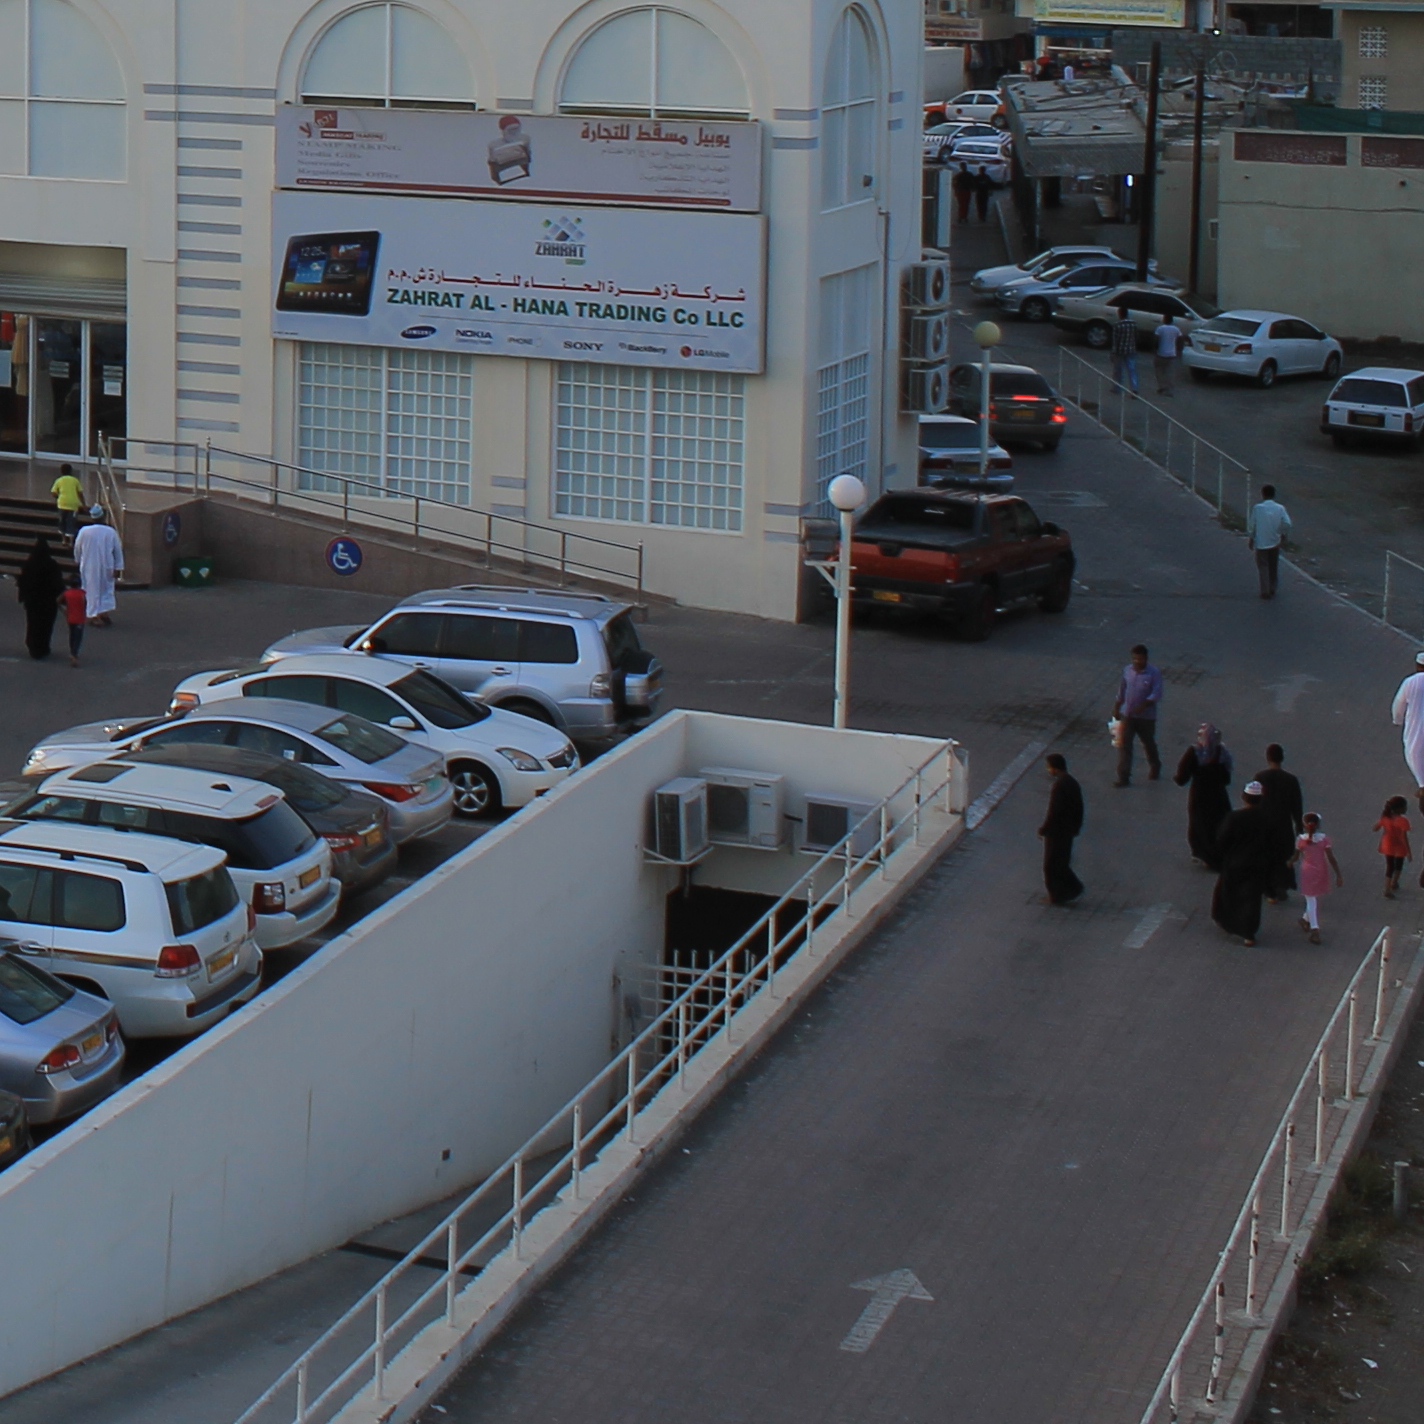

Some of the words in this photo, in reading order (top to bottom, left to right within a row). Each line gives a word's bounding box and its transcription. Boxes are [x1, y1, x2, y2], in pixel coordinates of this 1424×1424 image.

[581, 121, 630, 143] للتجارة
[635, 123, 688, 145] مسقط
[535, 241, 587, 258] ZAHRAT
[428, 268, 521, 288] للتجارة
[523, 276, 605, 292] الحناء
[608, 281, 669, 300] زهرة
[671, 284, 746, 303] شركة
[387, 288, 464, 308] ZAHRAT
[470, 295, 495, 311] AL
[513, 297, 569, 316] HANA
[575, 301, 666, 323] TRADING
[673, 308, 699, 325] Co
[706, 310, 744, 328] LLC
[455, 329, 493, 339] NOKIA
[563, 341, 603, 351] SONY
